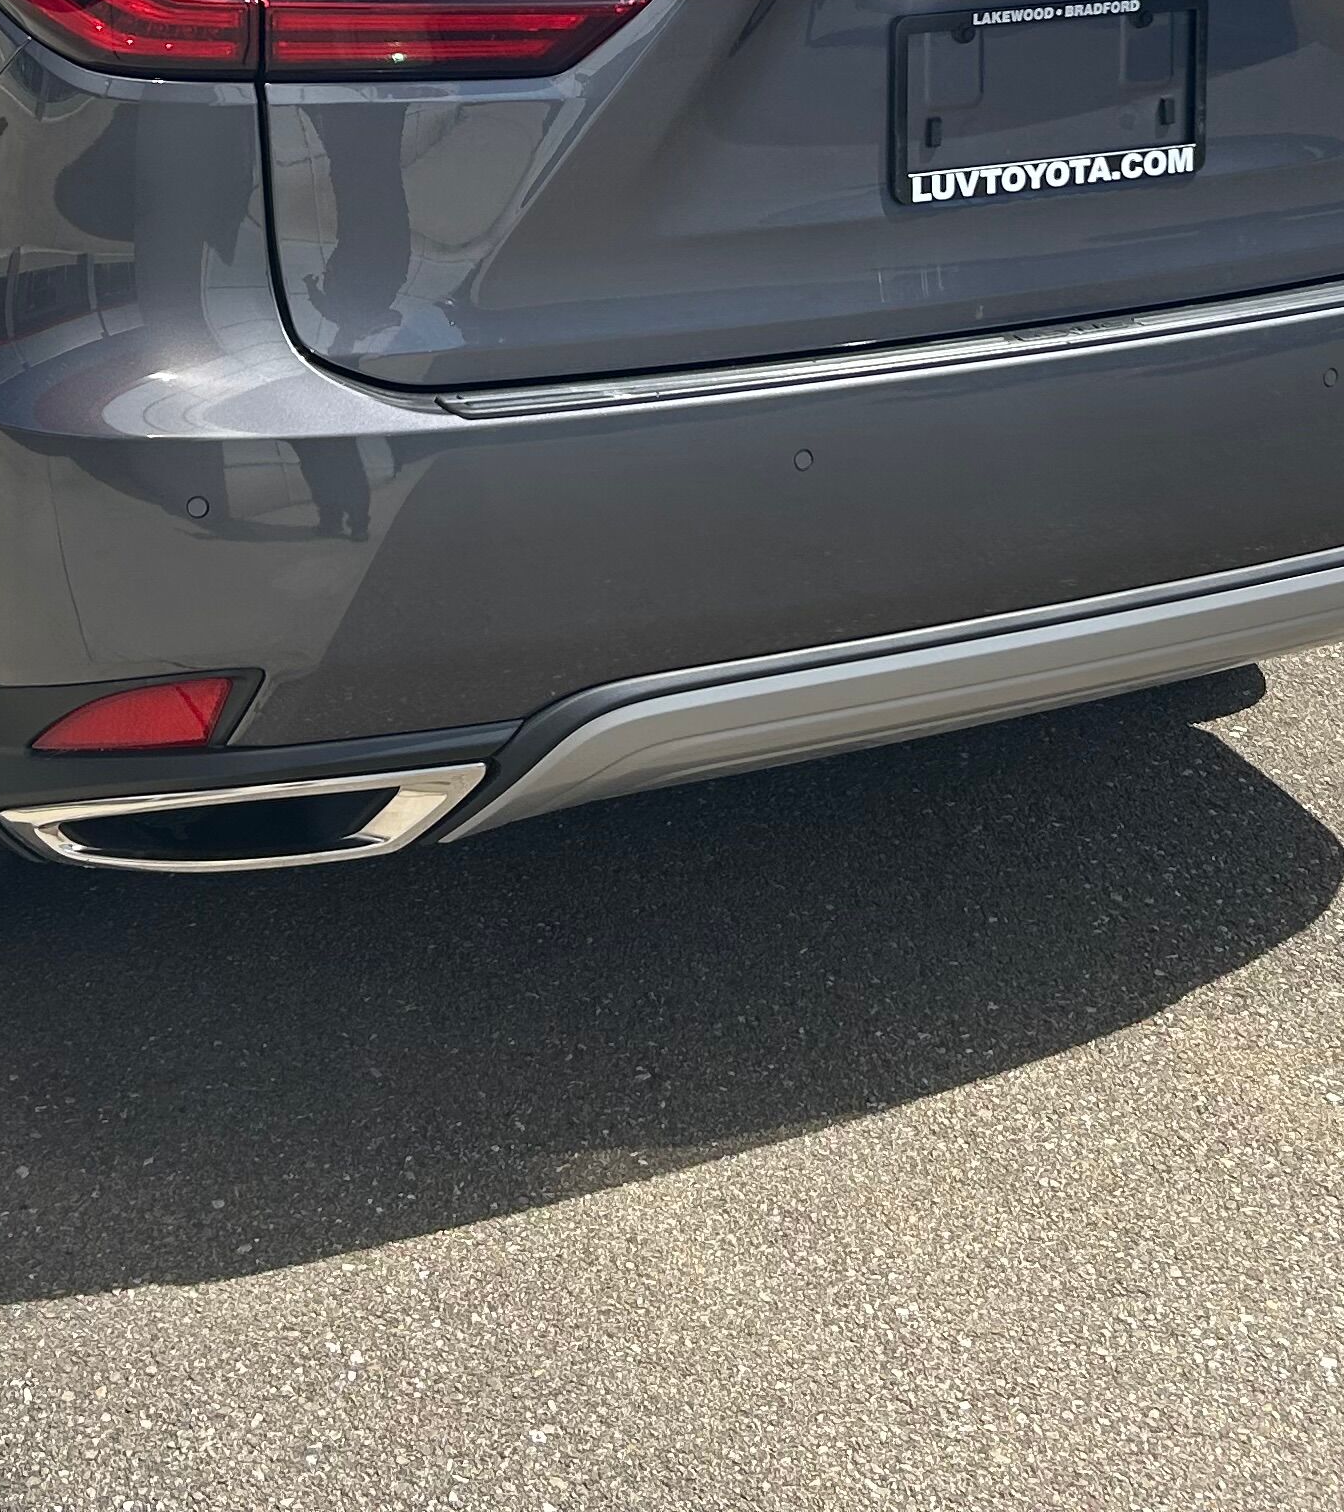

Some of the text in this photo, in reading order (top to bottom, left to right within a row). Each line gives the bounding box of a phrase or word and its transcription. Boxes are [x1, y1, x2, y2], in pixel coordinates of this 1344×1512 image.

[972, 0, 1141, 26] LAKEWOOD BRADFORD
[911, 146, 1196, 203] LUVTOYOTA.COM
